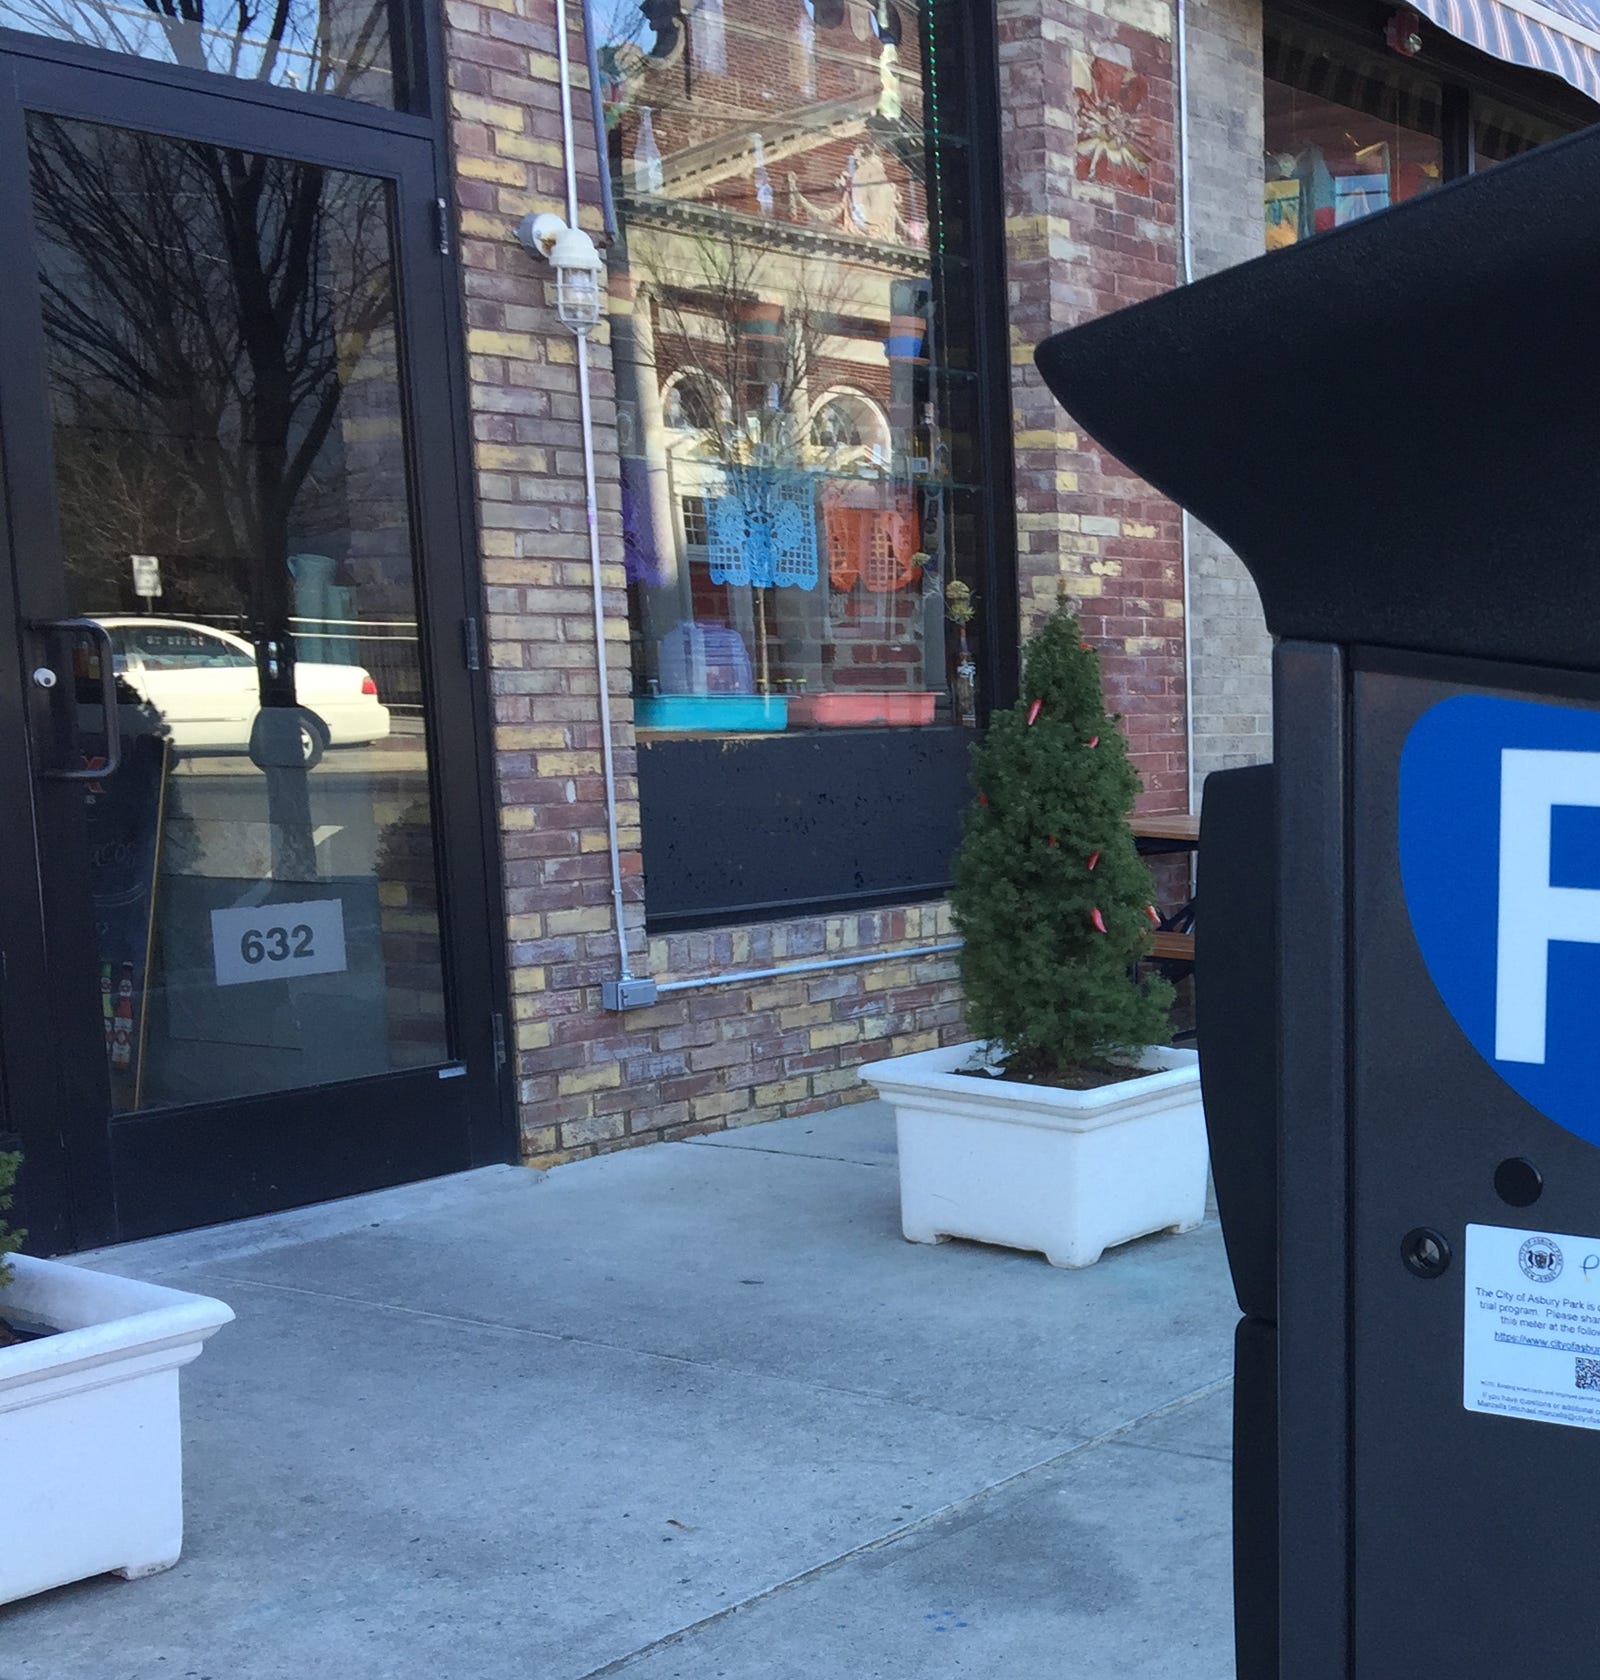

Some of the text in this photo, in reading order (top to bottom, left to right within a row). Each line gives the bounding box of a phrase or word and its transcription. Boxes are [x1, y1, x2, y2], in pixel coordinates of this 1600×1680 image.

[240, 923, 315, 965] 632
[1475, 1287, 1494, 1299] The
[1496, 1290, 1514, 1302] City
[1516, 1292, 1526, 1302] of
[1528, 1294, 1561, 1308] Asbury
[1562, 1298, 1585, 1310] Park
[1587, 1301, 1596, 1311] is
[1480, 1300, 1497, 1311] trial
[1546, 1308, 1579, 1322] Please
[1500, 1315, 1518, 1326] this
[1520, 1319, 1547, 1330] meter
[1548, 1322, 1558, 1332] at
[1560, 1323, 1576, 1334] the
